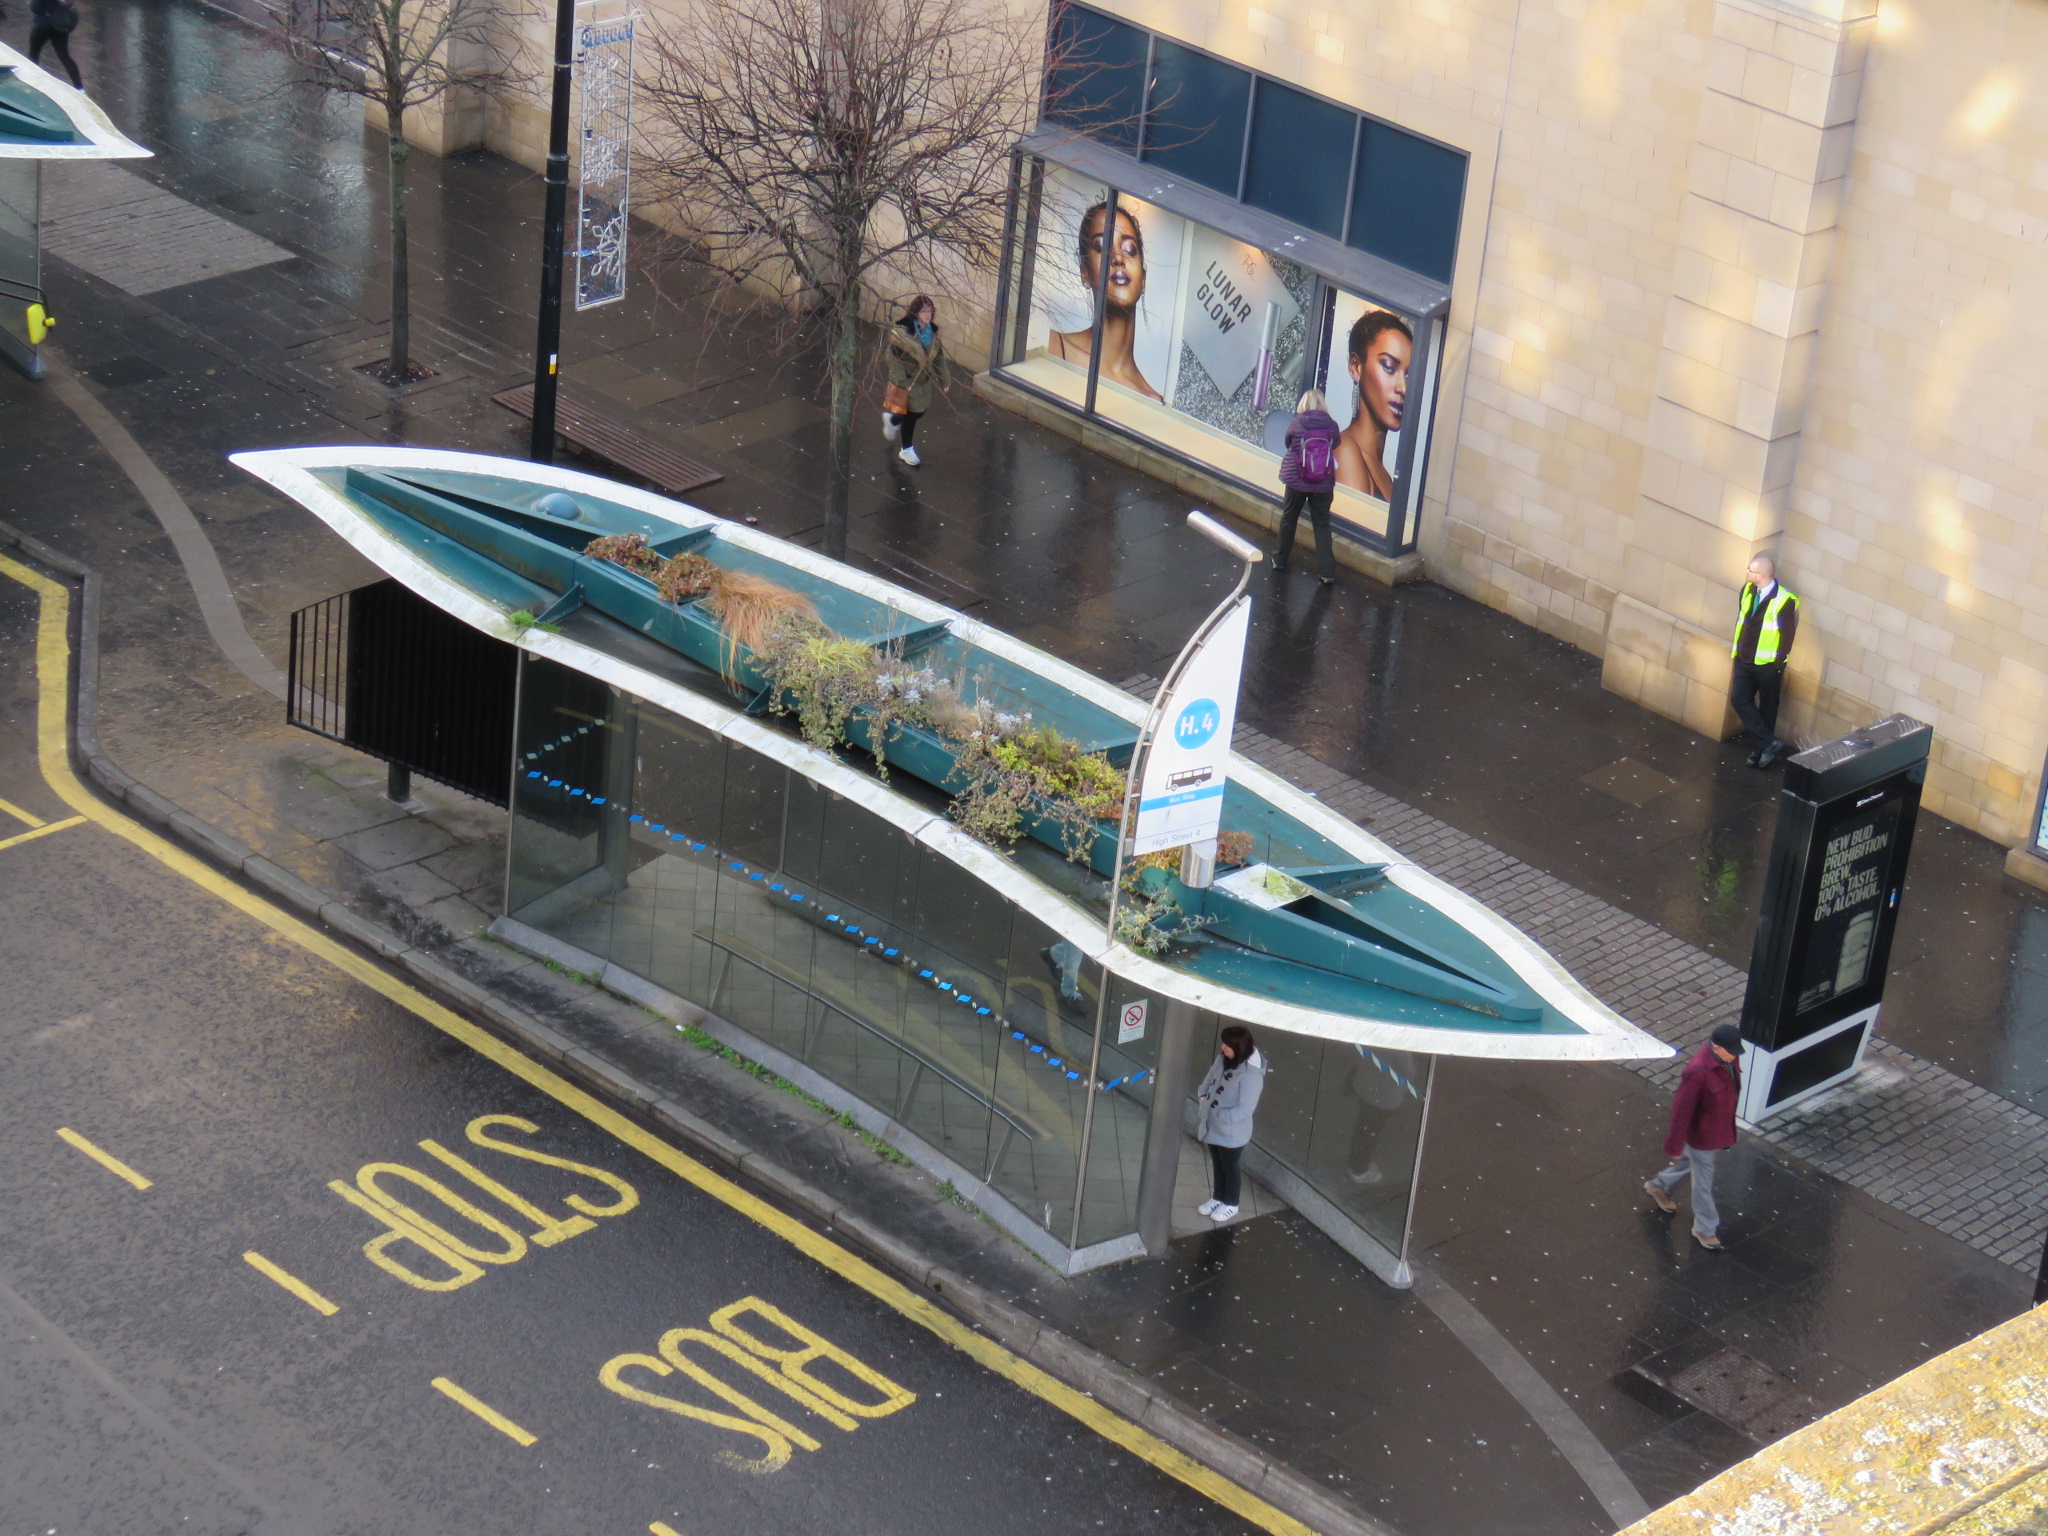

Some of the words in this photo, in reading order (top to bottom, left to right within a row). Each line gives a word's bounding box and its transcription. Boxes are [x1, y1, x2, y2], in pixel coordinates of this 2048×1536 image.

[1197, 283, 1236, 335] GLOW
[1205, 260, 1252, 324] LUNAR
[1152, 836, 1169, 848] High
[1170, 831, 1193, 844] Street
[1195, 828, 1201, 838] 4
[1823, 832, 1888, 873] PROHIBITION
[1826, 833, 1852, 857] NEW
[1851, 824, 1873, 846] BUD
[1818, 880, 1845, 906] 100%
[1820, 862, 1852, 889] BREW.
[1814, 900, 1832, 922] 0%
[328, 1114, 640, 1292] STOP
[598, 1296, 917, 1475] BUS
